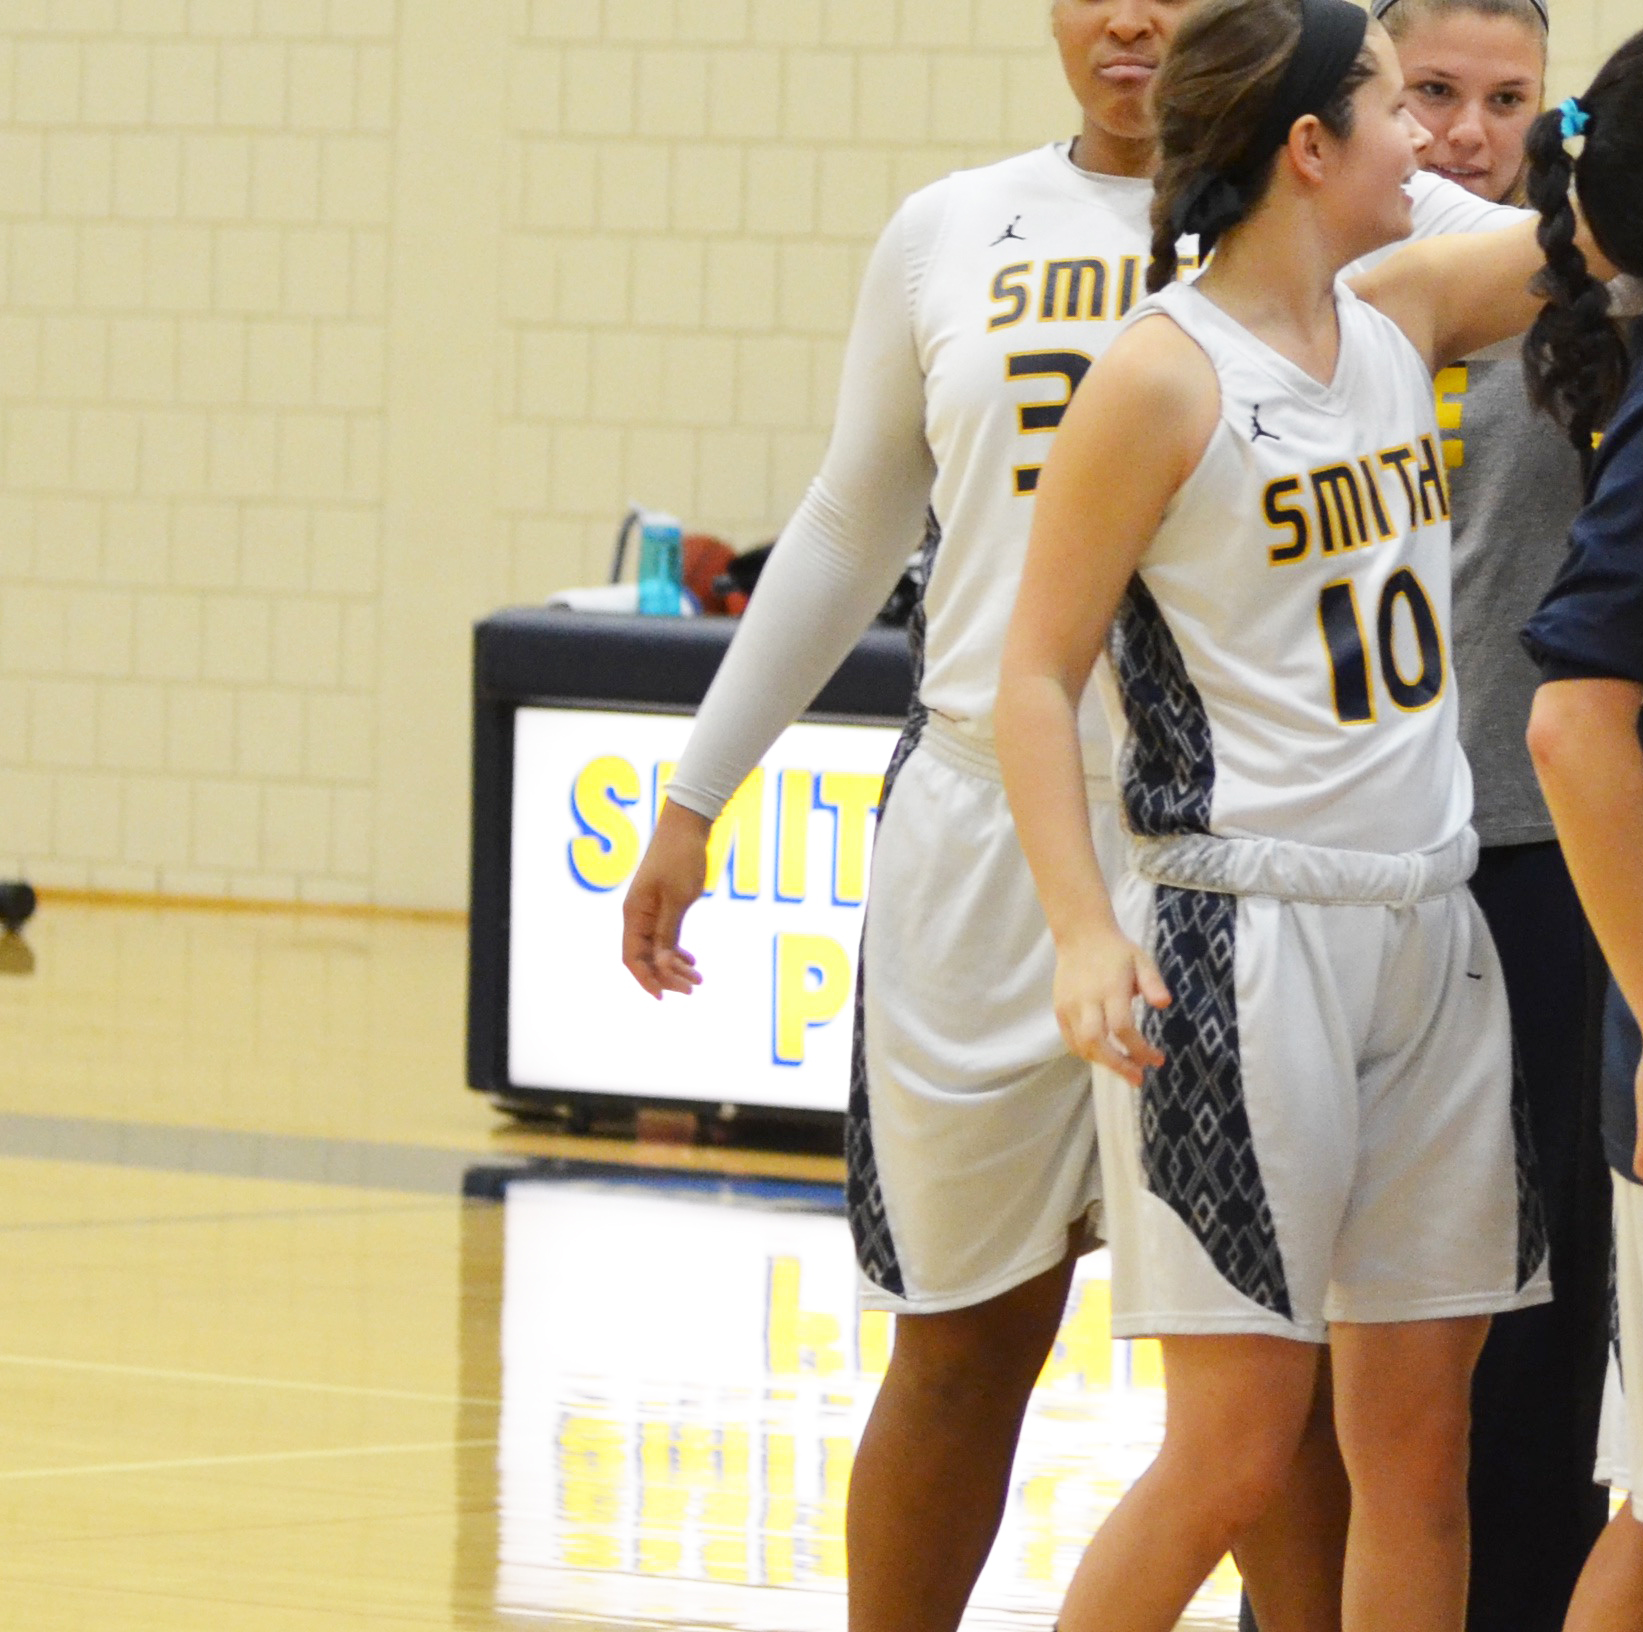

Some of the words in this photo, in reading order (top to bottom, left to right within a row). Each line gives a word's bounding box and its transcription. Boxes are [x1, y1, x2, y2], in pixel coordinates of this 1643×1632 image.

[986, 254, 1215, 333] SMI
[1262, 433, 1451, 566] SMITH
[1319, 565, 1446, 726] 10
